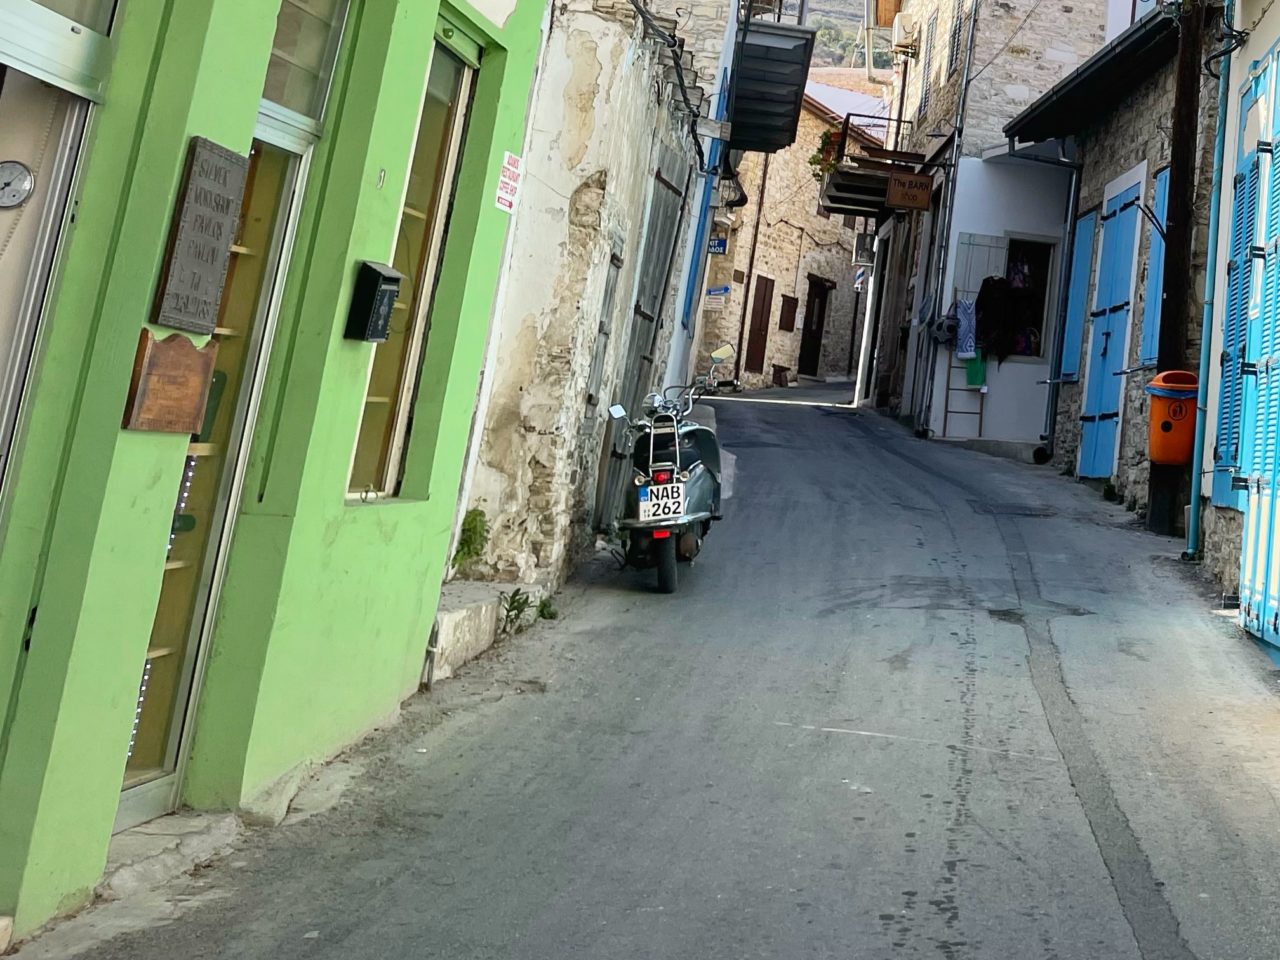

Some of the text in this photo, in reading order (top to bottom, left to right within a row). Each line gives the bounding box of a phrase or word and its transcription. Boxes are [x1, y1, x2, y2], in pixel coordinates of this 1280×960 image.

[893, 178, 929, 191] The BARN
[650, 485, 681, 502] NAB
[652, 501, 682, 517] 262
